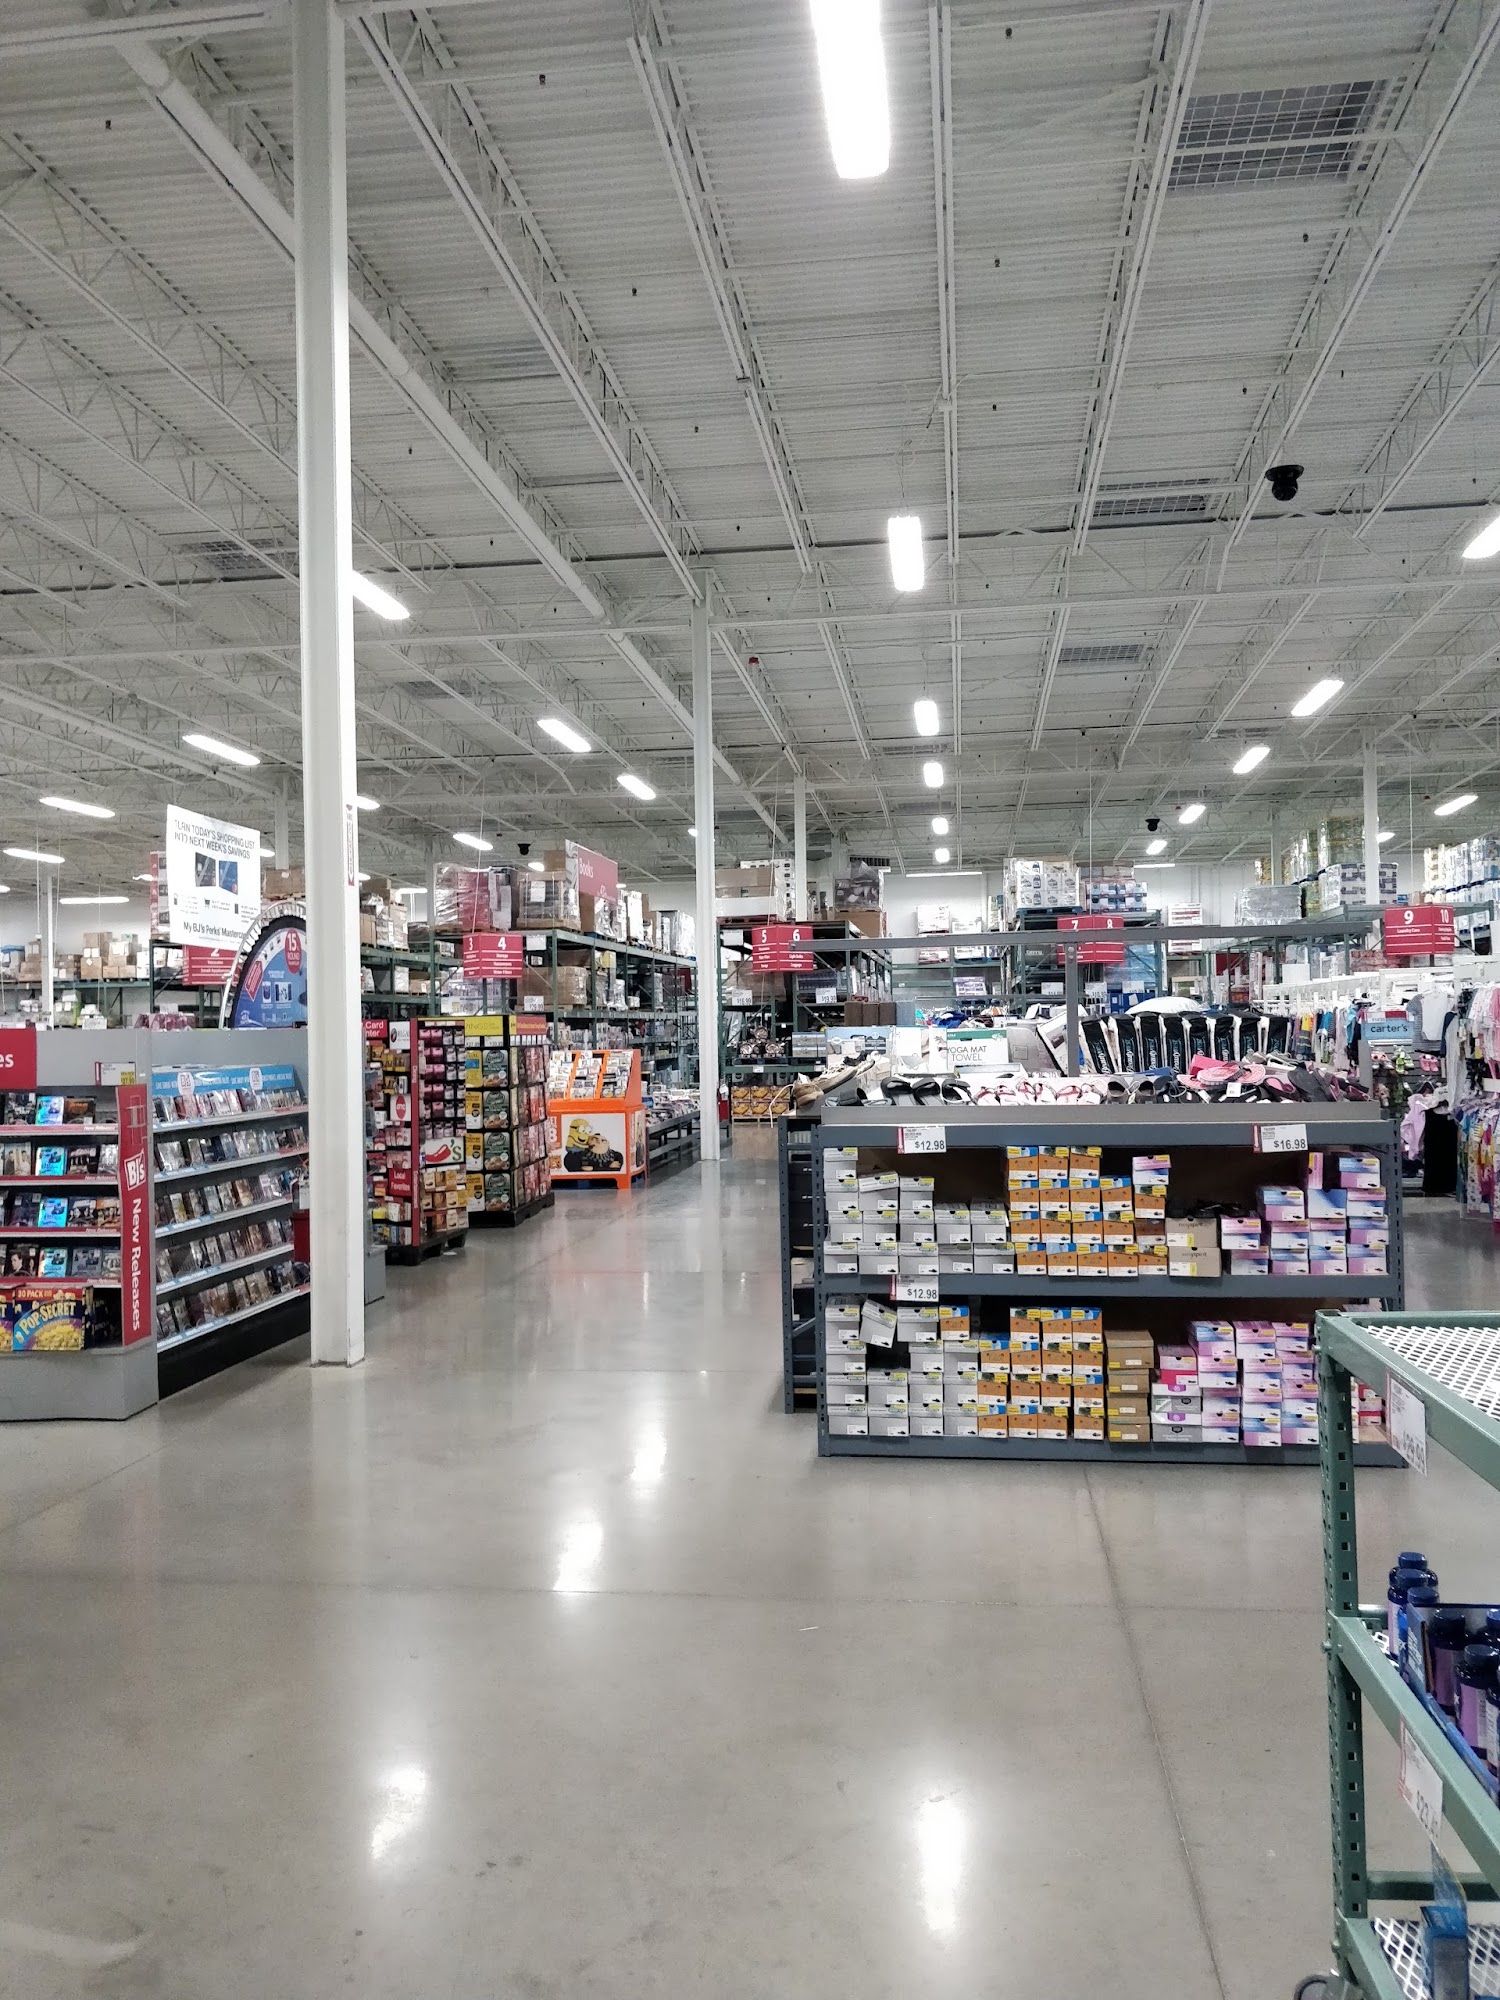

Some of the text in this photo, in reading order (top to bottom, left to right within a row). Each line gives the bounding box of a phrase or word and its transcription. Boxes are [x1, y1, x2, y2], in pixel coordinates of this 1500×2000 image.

[192, 824, 215, 839] TODAY'S
[216, 832, 244, 847] SHOPPING
[244, 840, 255, 849] LIST
[190, 836, 205, 848] NEXT
[206, 840, 227, 854] WEEK'S
[228, 846, 250, 860] SAVINGS
[580, 858, 593, 878] Books
[1404, 910, 1414, 924] 9
[1440, 909, 1449, 923] 10
[184, 922, 192, 933] My
[192, 923, 205, 934] BJ's
[1071, 920, 1078, 930] 7
[1107, 919, 1113, 929] 8
[762, 929, 767, 943] 5
[793, 929, 800, 941] 6
[469, 937, 473, 950] 3
[498, 936, 506, 950] 4
[365, 1021, 383, 1029] Card
[1370, 1023, 1408, 1032] carter's
[915, 1140, 945, 1150] $12.98
[1274, 1139, 1306, 1150] $16.98
[127, 1157, 145, 1186] BJ's
[131, 1198, 141, 1331] New Releases
[18, 1290, 26, 1298] 30
[907, 1289, 937, 1299] $12.98
